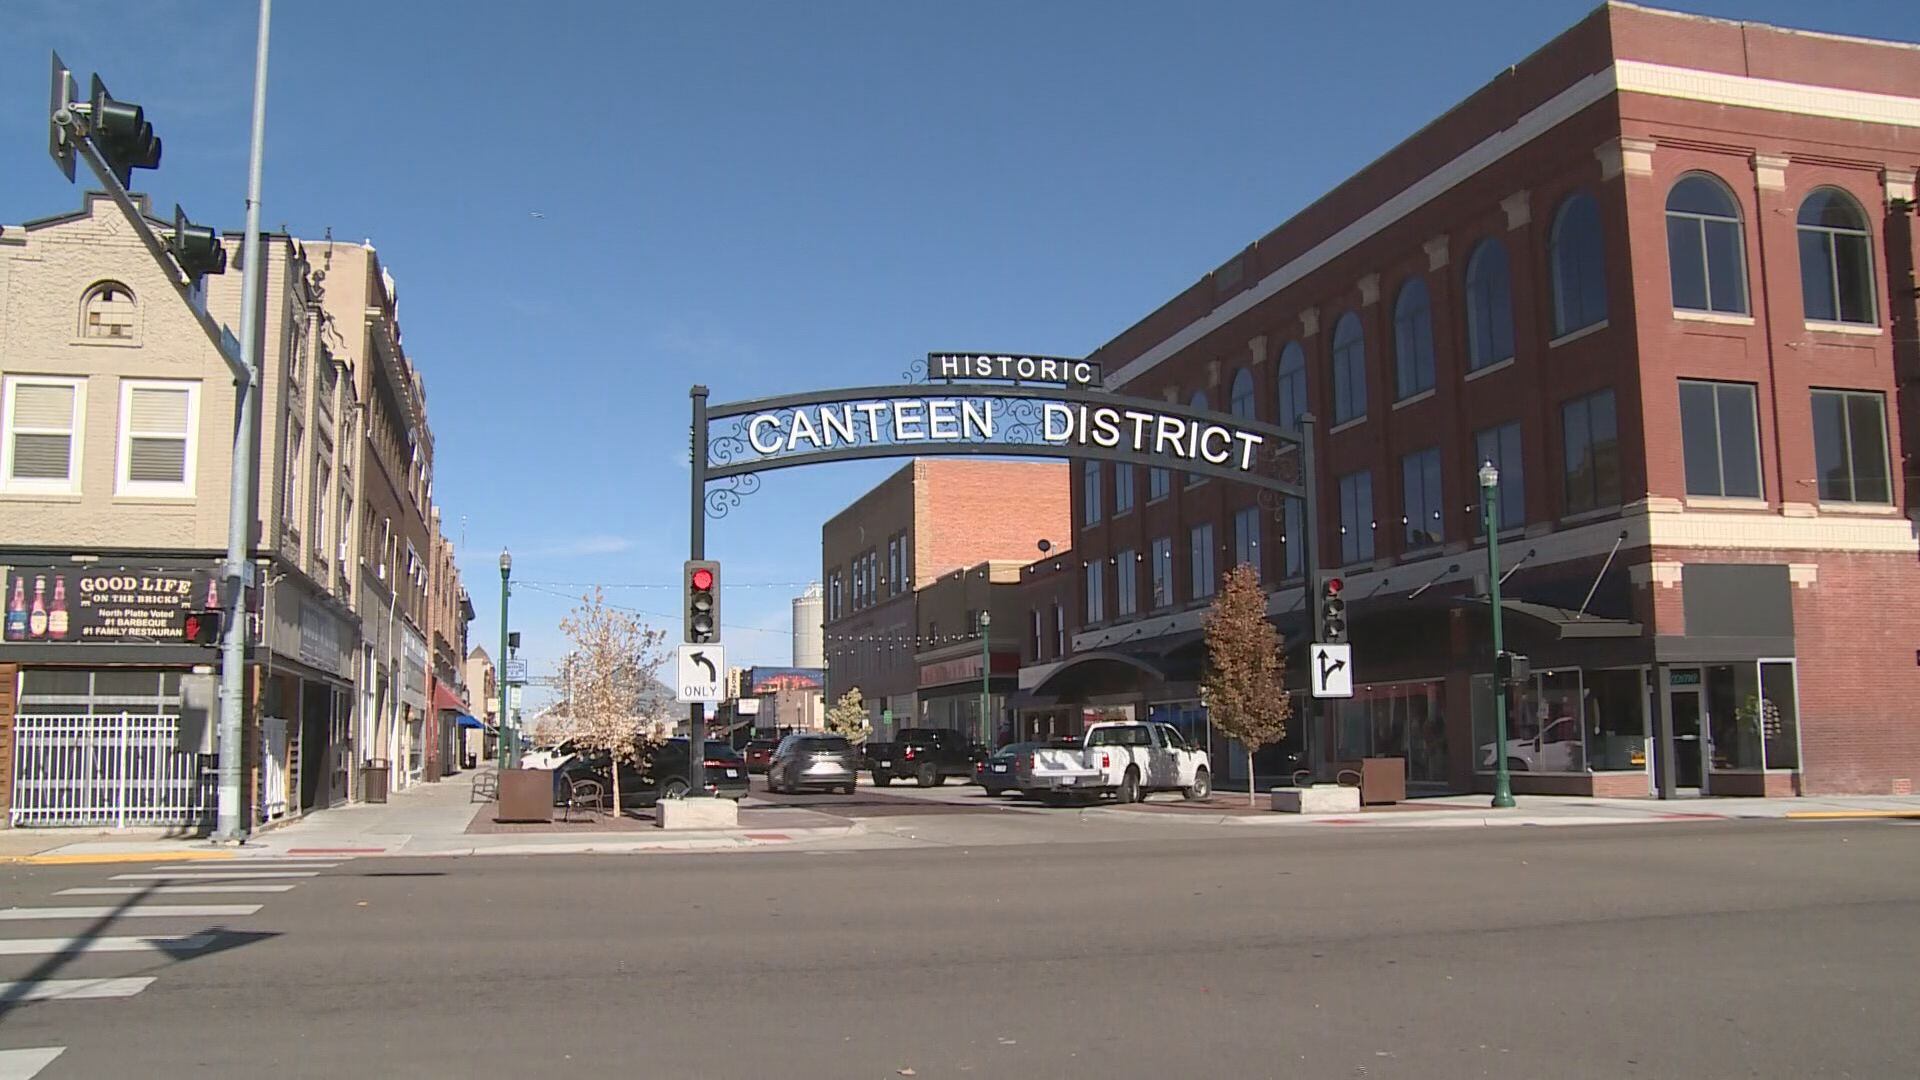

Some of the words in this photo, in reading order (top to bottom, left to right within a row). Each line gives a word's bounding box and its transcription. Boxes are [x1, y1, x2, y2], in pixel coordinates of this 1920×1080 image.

[941, 355, 1091, 383] HISTORIC
[748, 400, 993, 454] CANTEEN
[1043, 403, 1263, 470] DISTRICT
[80, 577, 137, 592] GOOD
[142, 577, 191, 594] LIFE
[93, 594, 109, 602] ON
[112, 594, 134, 603] THE
[138, 595, 179, 604] BRICKS
[99, 609, 122, 618] North
[124, 609, 148, 618] Platte
[150, 609, 174, 618] Voted
[104, 618, 114, 626] #1
[117, 619, 167, 627] BARBEQUE
[83, 627, 93, 635] #1
[95, 627, 127, 636] FAMILY
[128, 627, 182, 637] RESTAURAN
[685, 686, 717, 697] ONLY
